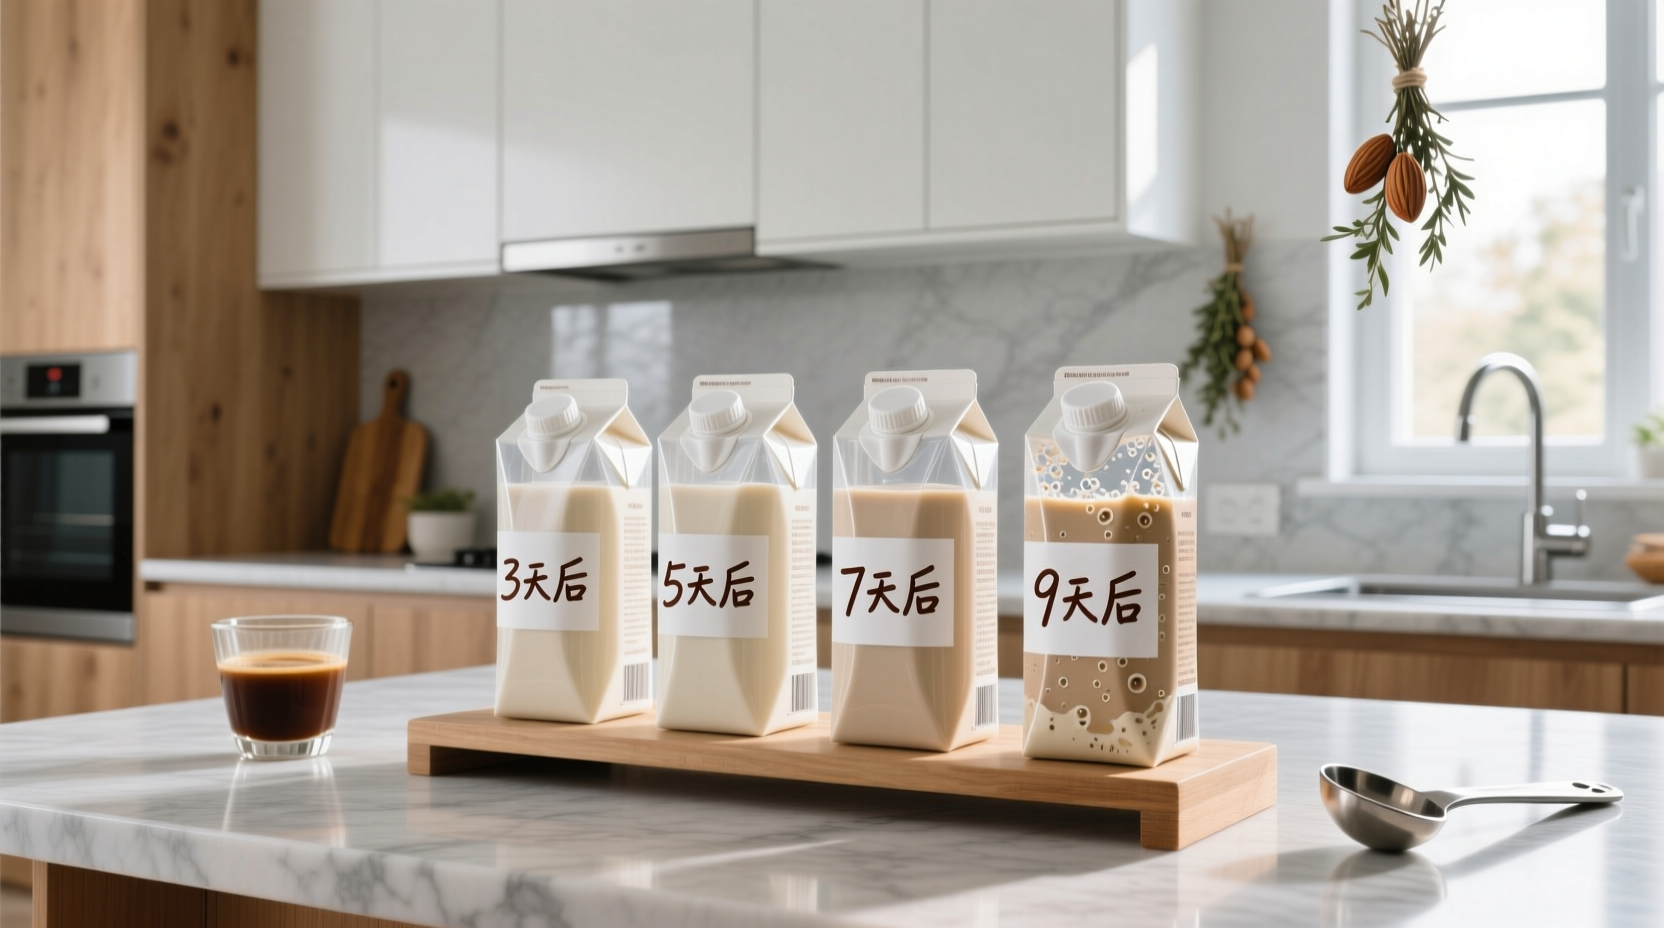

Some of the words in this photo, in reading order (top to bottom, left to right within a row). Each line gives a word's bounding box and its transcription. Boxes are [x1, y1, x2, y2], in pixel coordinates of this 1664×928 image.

[500, 557, 588, 602] 3天后
[662, 560, 755, 609] 5天后
[840, 564, 941, 617] 7天后
[1034, 568, 1143, 628] 9天后
